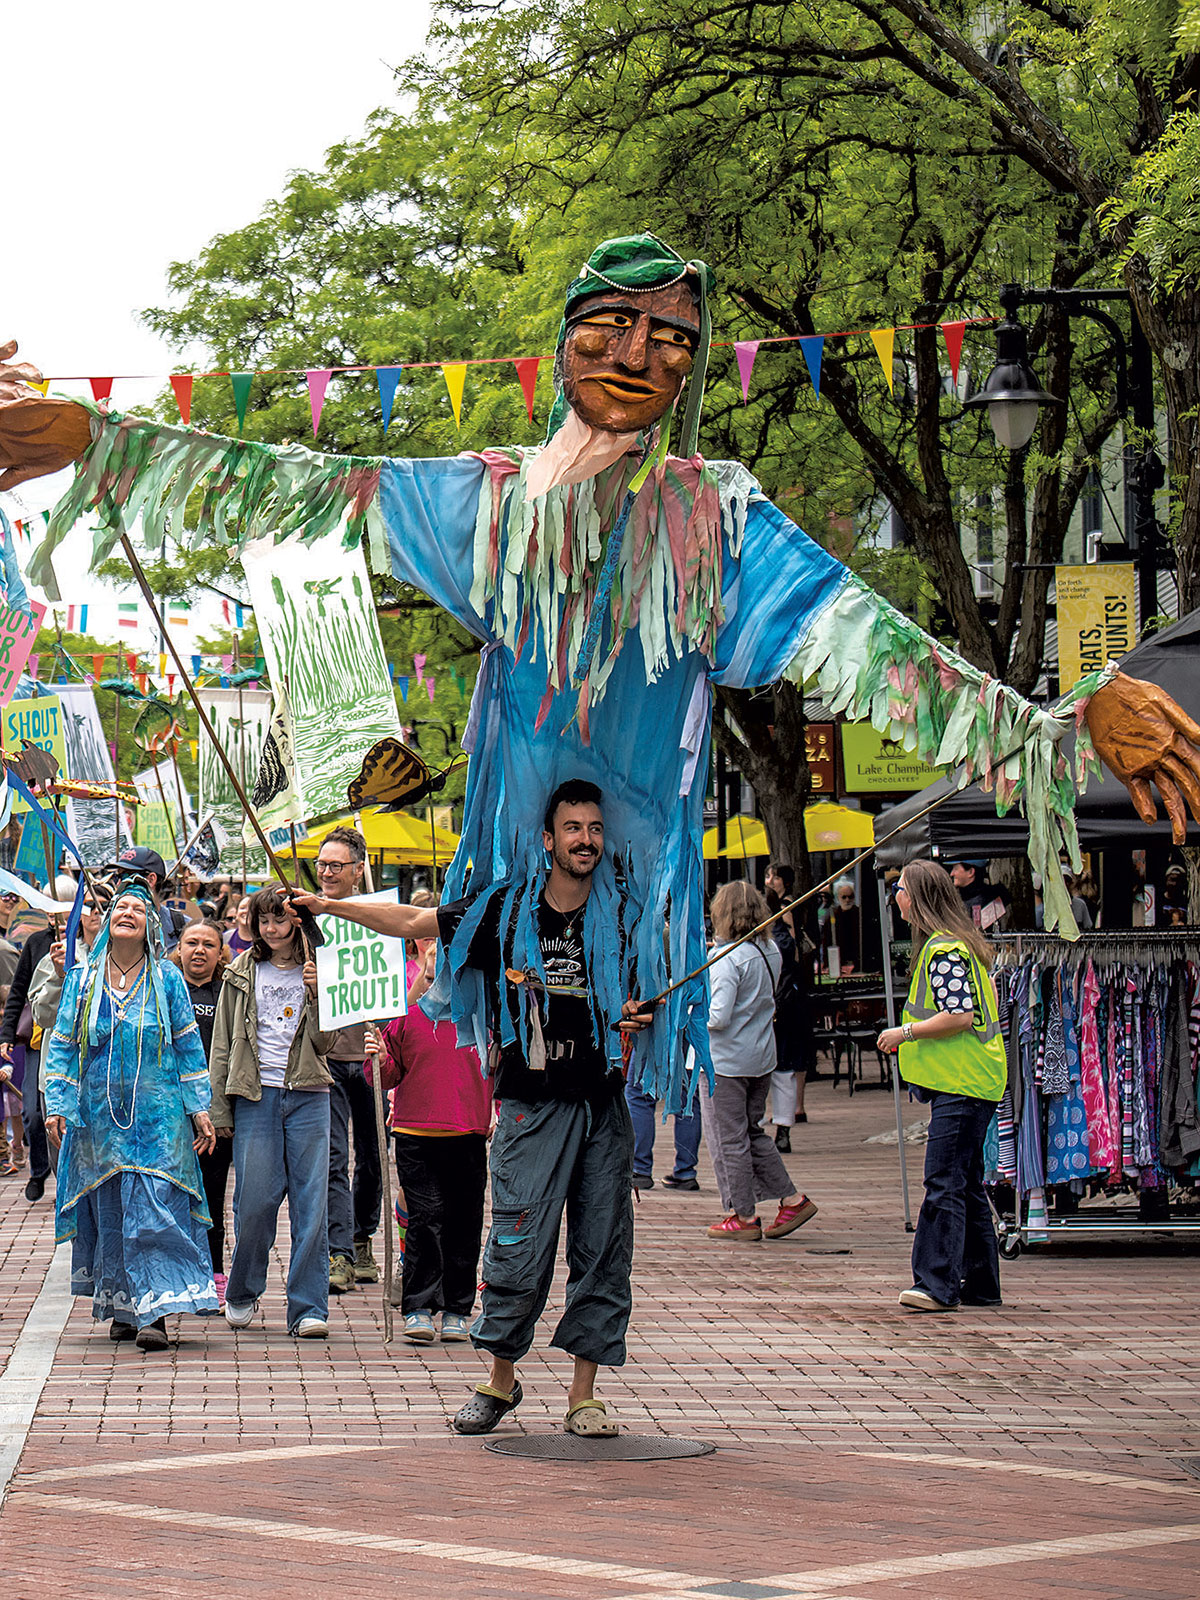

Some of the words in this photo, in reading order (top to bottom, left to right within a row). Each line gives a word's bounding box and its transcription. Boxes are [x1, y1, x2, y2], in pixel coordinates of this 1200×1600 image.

[8, 707, 58, 741] SHOUT
[857, 764, 882, 776] Lake
[146, 824, 169, 840] FOR
[337, 941, 387, 981] FOR
[326, 974, 399, 1018] TROUT!
